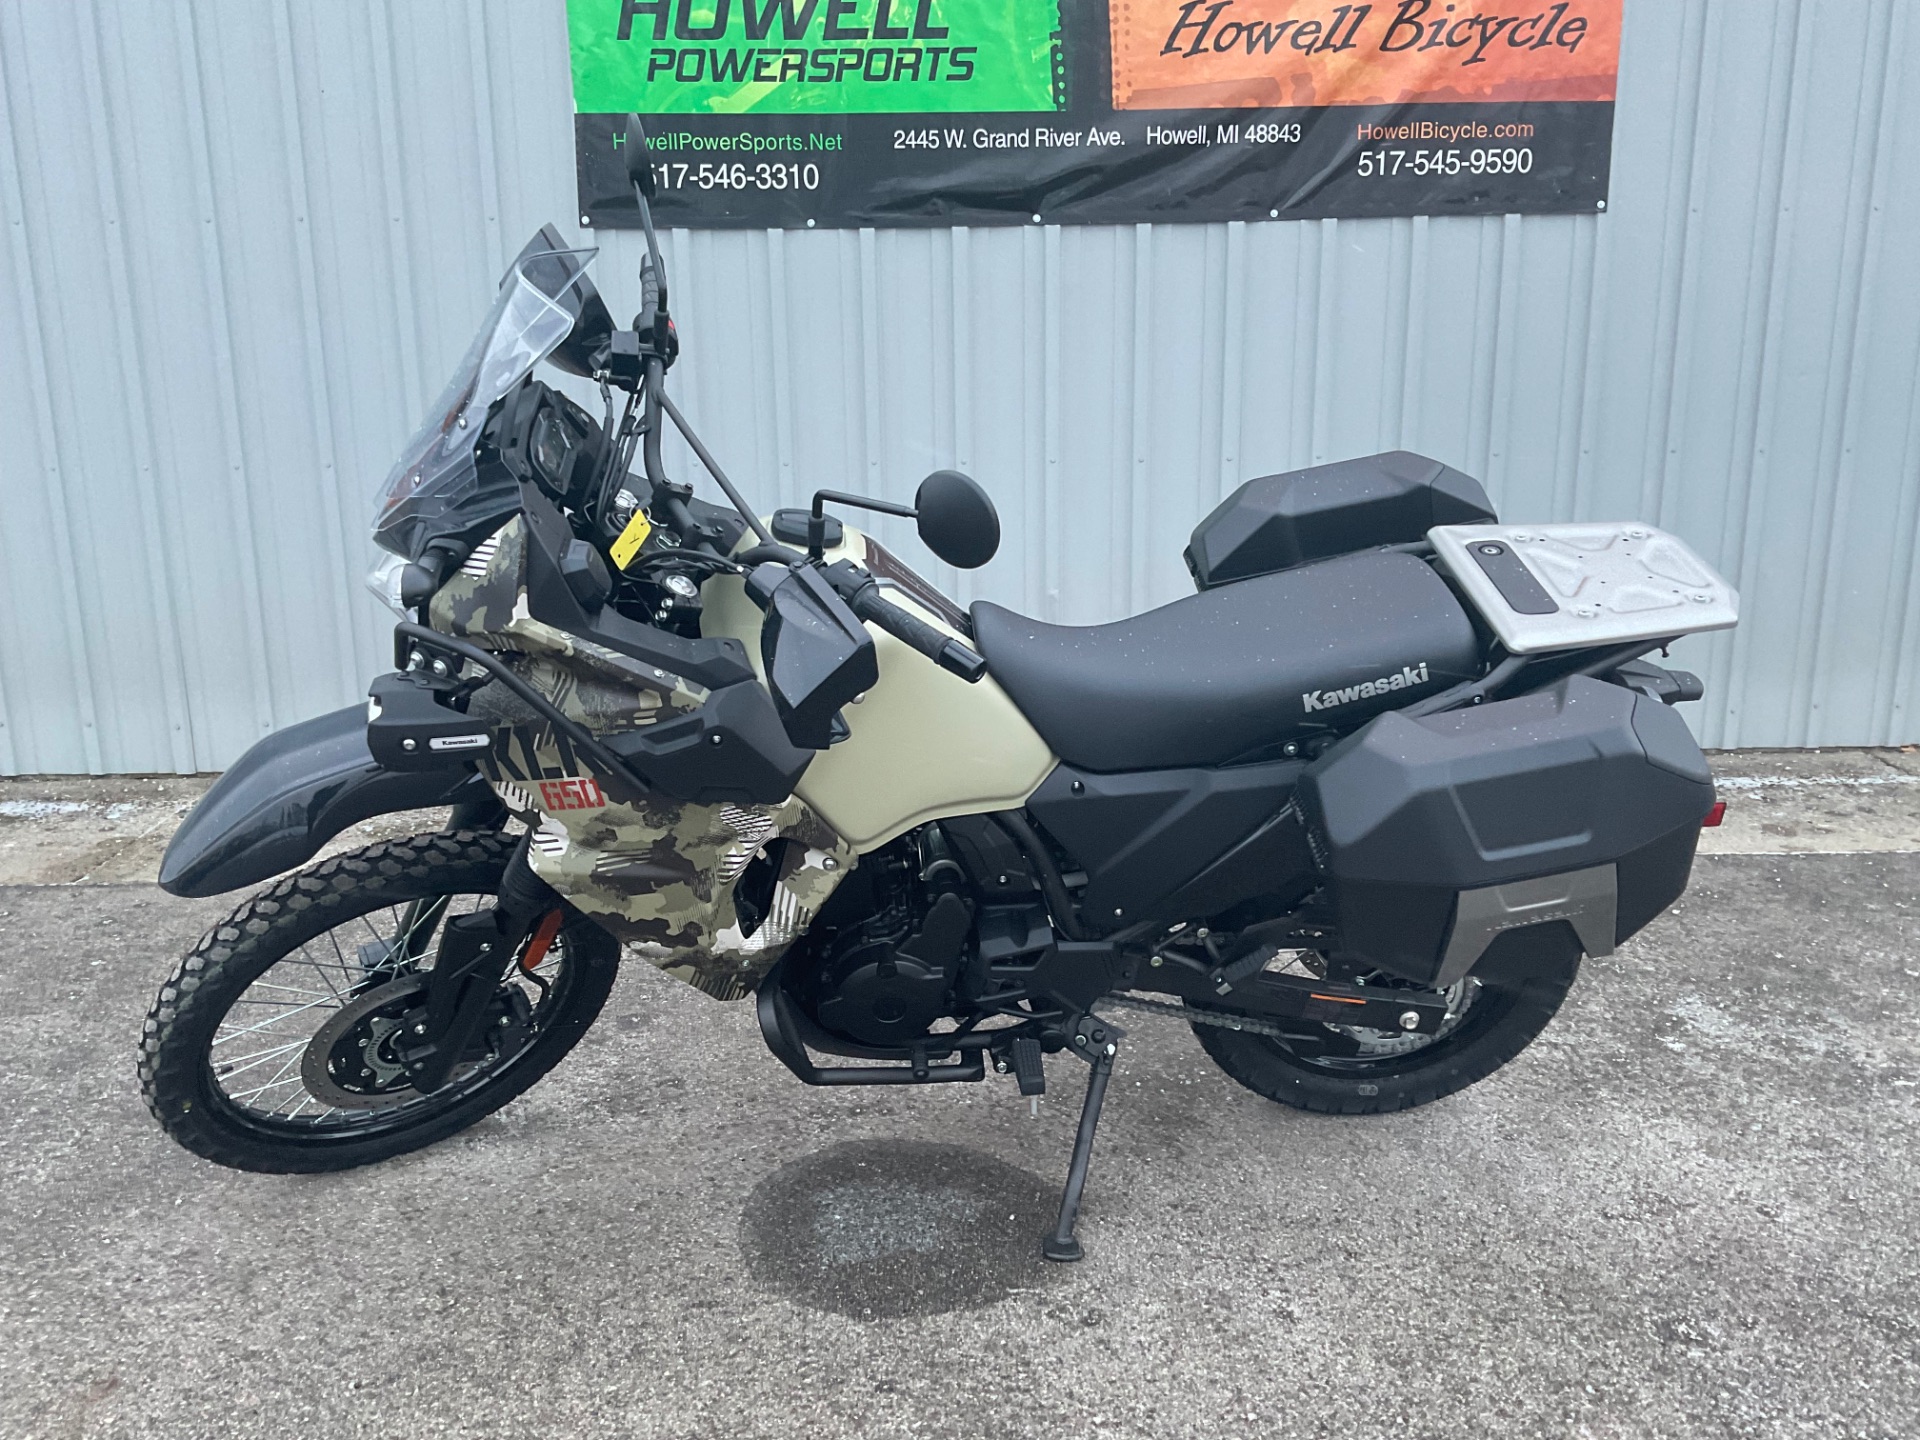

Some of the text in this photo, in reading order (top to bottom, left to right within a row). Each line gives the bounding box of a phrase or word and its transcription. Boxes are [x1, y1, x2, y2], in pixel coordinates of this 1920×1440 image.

[616, 0, 950, 41] HOWELL
[1159, 0, 1588, 66] Howell Bicycle
[646, 47, 978, 83] POWERSPORTS
[612, 131, 843, 155] HwellPowerSports.Net
[893, 123, 1301, 149] 2445 W. Grand River Ave. Howell, MI 48843
[1357, 121, 1535, 143] HowellBicycle.com
[650, 162, 820, 190] 17-546-3310
[1357, 147, 1533, 177] 517-545-9590
[1302, 661, 1430, 713] Kawasaki
[539, 778, 606, 811] 650
